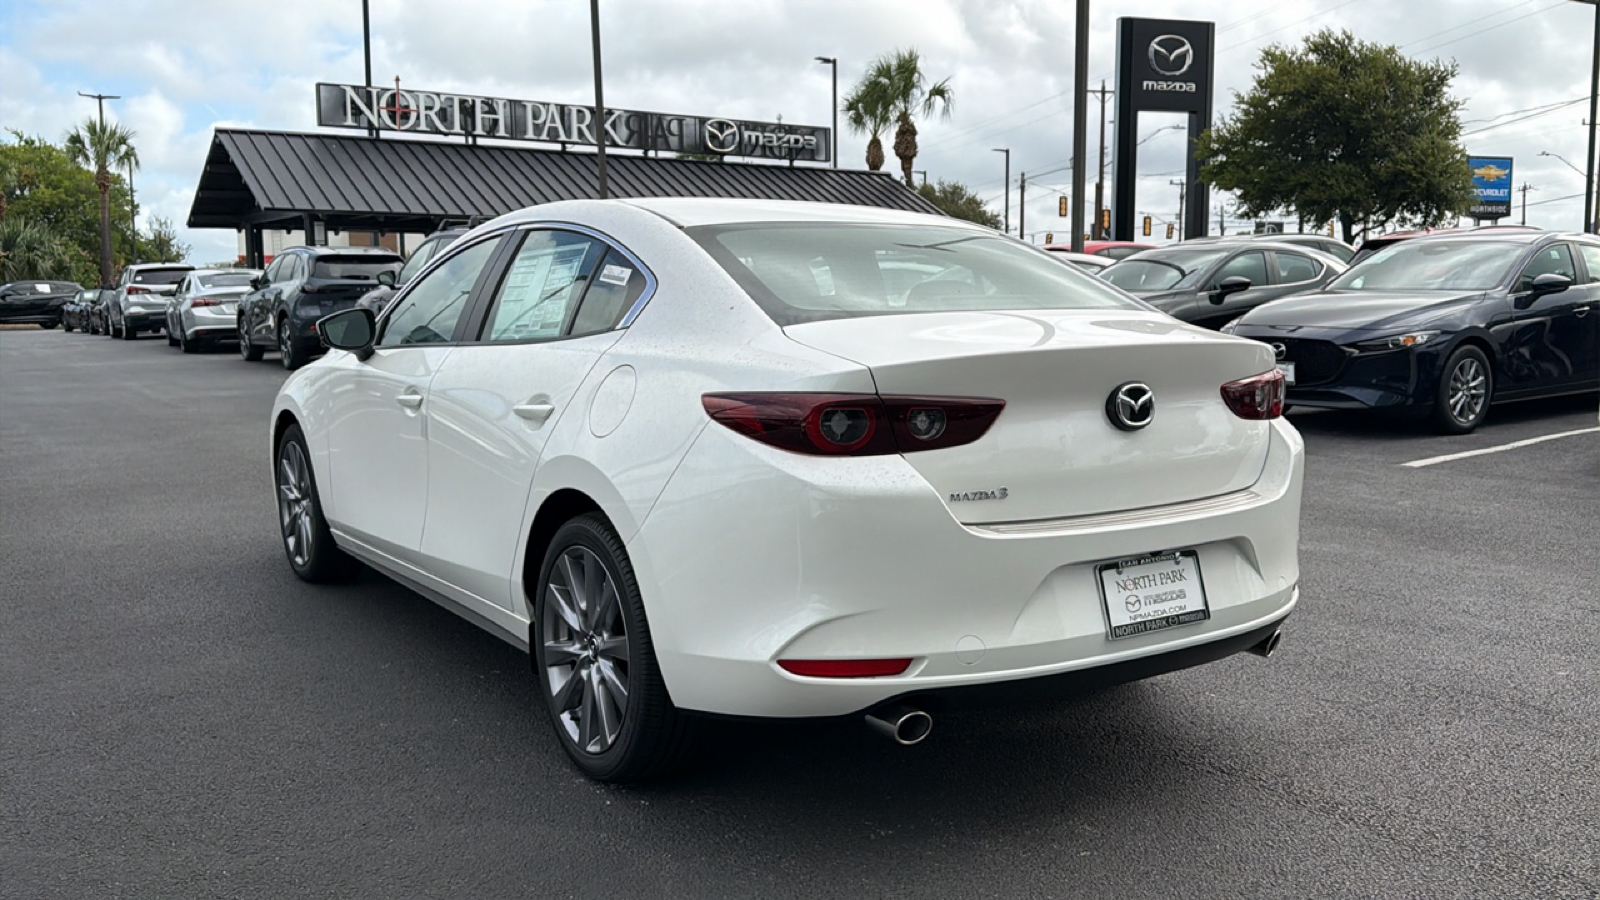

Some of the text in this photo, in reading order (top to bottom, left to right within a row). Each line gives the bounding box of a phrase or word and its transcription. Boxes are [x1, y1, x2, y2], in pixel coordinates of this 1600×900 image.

[1142, 80, 1196, 93] mazda
[340, 85, 627, 146] NORTH PARK
[743, 130, 817, 150] mazda
[1115, 569, 1187, 593] NORTH PARK
[1129, 604, 1187, 621] NPMAZDA.COM
[1115, 622, 1146, 637] NORTH
[1146, 618, 1170, 633] PARK
